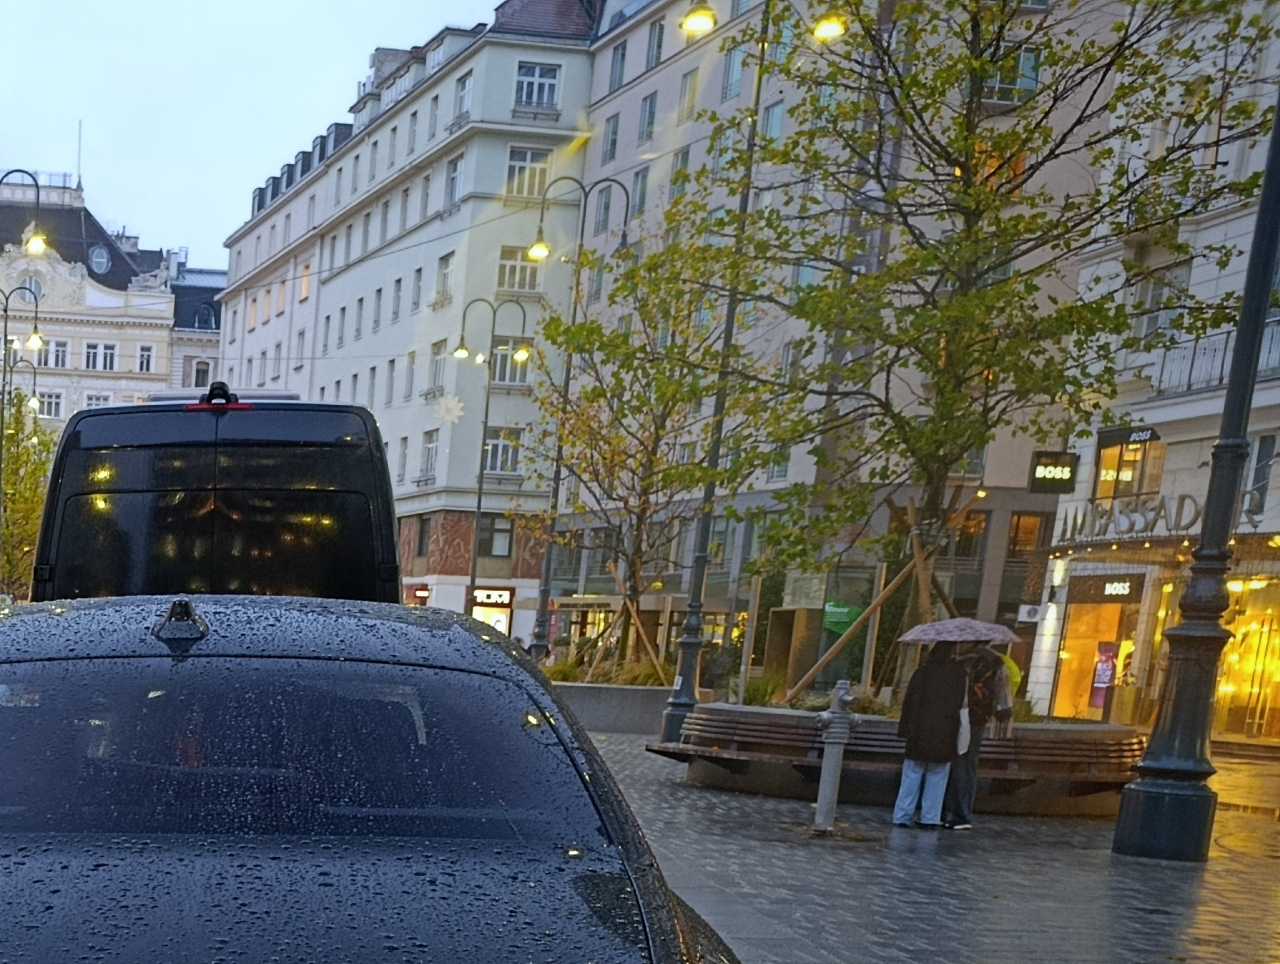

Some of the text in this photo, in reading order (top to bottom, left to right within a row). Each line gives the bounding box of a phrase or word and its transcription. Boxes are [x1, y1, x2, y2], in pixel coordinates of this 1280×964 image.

[1130, 430, 1151, 441] BOSS
[1035, 465, 1071, 479] BOSS
[1058, 489, 1264, 543] AMBASSADR
[1104, 582, 1130, 595] BOSS
